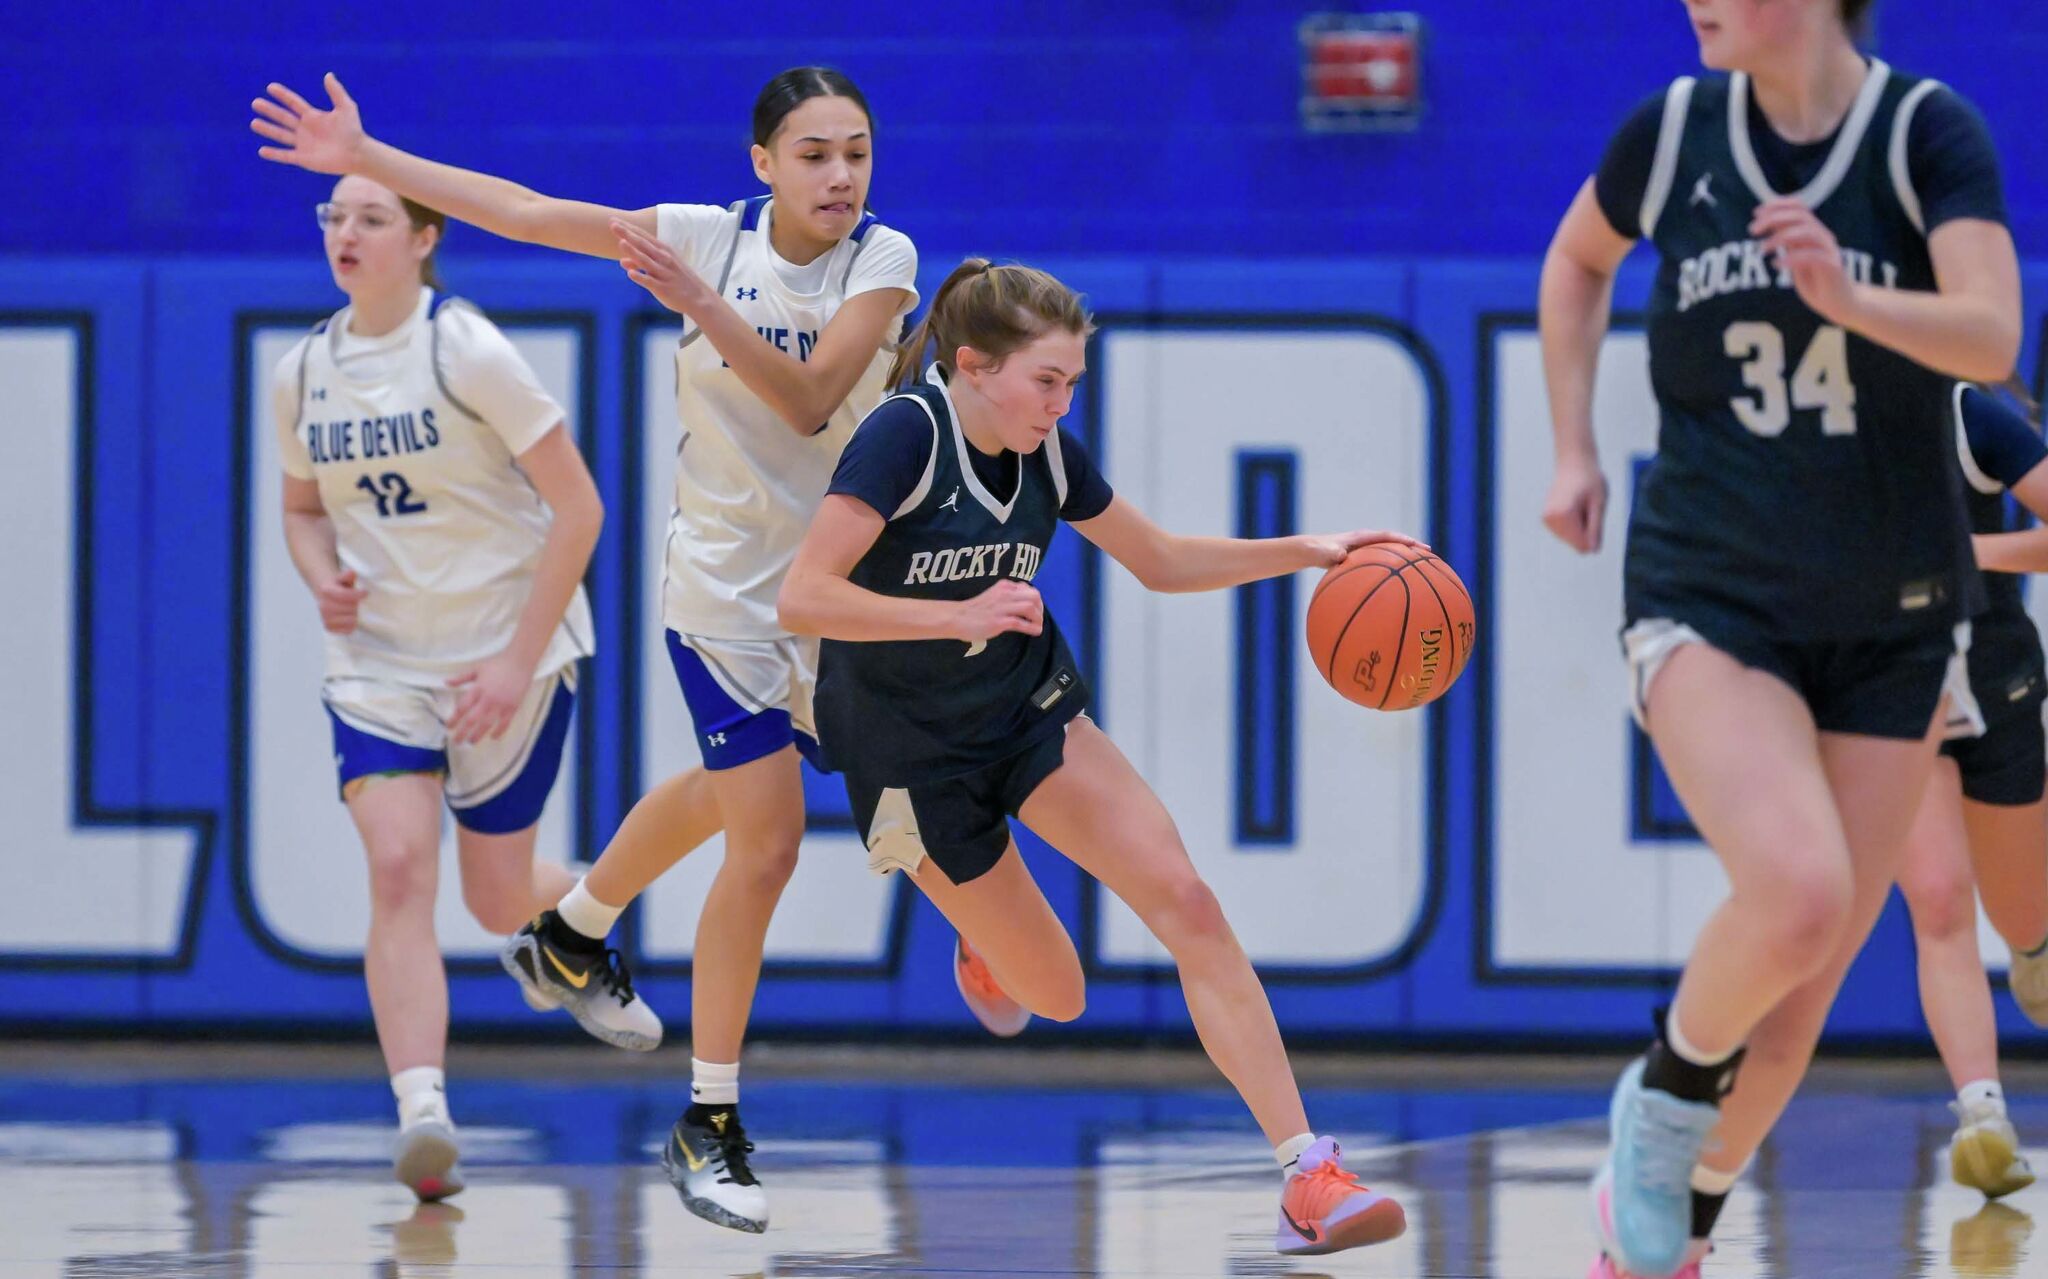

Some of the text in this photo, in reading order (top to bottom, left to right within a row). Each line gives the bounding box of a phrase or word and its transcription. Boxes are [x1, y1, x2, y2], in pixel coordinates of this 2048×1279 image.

[1722, 320, 1857, 437] 34
[307, 407, 439, 463] BLUE DEVILS
[356, 471, 428, 517] 12
[903, 542, 1041, 585] ROCKY HIL
